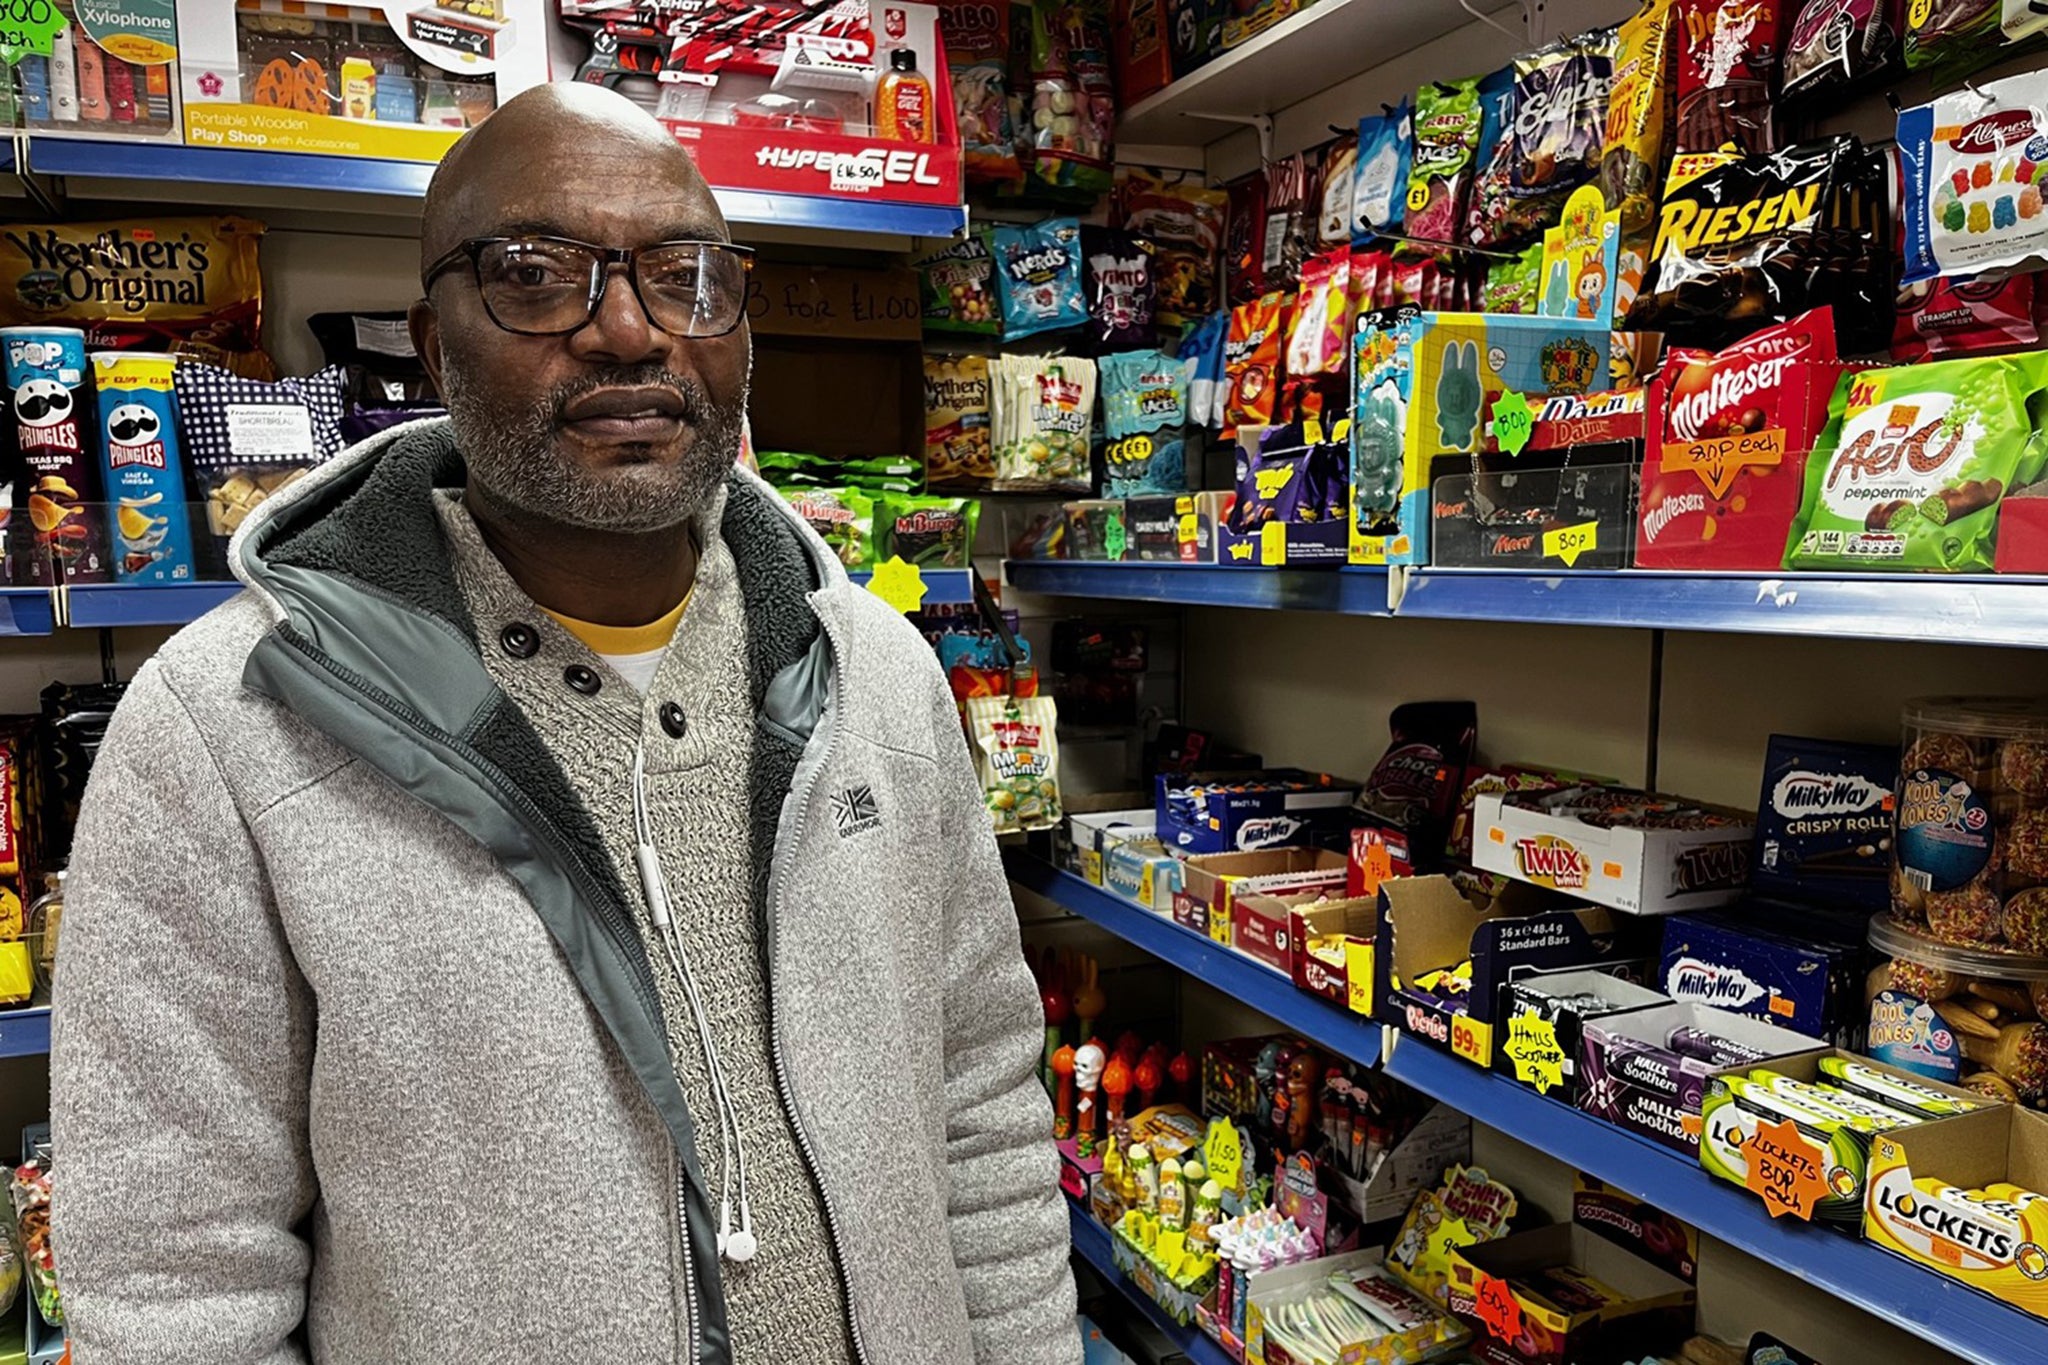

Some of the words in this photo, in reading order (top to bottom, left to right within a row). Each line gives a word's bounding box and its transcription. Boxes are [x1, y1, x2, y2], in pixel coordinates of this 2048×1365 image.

[0, 0, 51, 24] .00
[84, 8, 171, 29] Xylophone
[939, 5, 997, 30] RIBO
[190, 111, 248, 126] Portable
[251, 115, 309, 130] Wooden
[191, 128, 224, 143] Play
[228, 129, 267, 146] Shop
[271, 136, 293, 146] with
[296, 138, 360, 151] Accessories
[755, 147, 833, 171] HYPE
[1411, 189, 1426, 204] £1
[1650, 183, 1820, 263] RIESEN
[4, 228, 210, 273] Werther's
[62, 264, 206, 311] Original
[750, 281, 769, 318] 3
[852, 283, 918, 321] £1.00
[1919, 310, 1957, 324] STRAIGHT
[1959, 308, 1971, 317] UP
[84, 329, 118, 347] dies
[10, 341, 63, 368] POP
[934, 394, 985, 412] Original
[18, 422, 77, 450] PRINGLES
[1552, 420, 1609, 447] Daim
[1739, 433, 1779, 454] each
[109, 444, 163, 467] PRINGLES
[1135, 441, 1148, 451] £1
[1827, 418, 1963, 490] Aero
[26, 457, 51, 465] TEXAS
[1844, 485, 1927, 501] peppermint
[1643, 493, 1704, 544] Maltesers
[1493, 534, 1535, 556] Mars
[1823, 532, 1839, 542] 144
[991, 752, 1049, 771] Muay
[1906, 779, 1942, 803] KOOL
[1786, 818, 1843, 835] CRISPY
[1846, 817, 1893, 831] ROLL
[1900, 803, 1949, 830] KONES
[1519, 838, 1580, 875] Twix
[1500, 927, 1514, 938] 36
[1532, 923, 1555, 936] 48.4
[1499, 936, 1546, 952] Standard
[1548, 934, 1571, 947] Bars
[1406, 1004, 1448, 1043] Picnic
[1872, 1002, 1908, 1024] KOOL
[1515, 1025, 1554, 1047] HALLS
[1870, 1024, 1915, 1047] KONES
[1635, 1056, 1668, 1076] HALLS
[1624, 1062, 1679, 1094] Soothers
[1637, 1096, 1683, 1120] HALLS
[1627, 1105, 1699, 1145] Soothers
[1752, 1130, 1817, 1181] LOCKETS
[1881, 1142, 1895, 1156] 20
[1444, 1190, 1501, 1229] MONEY
[1578, 1204, 1642, 1238] DOUGHNUTS
[1879, 1186, 2013, 1259] LOCKETS
